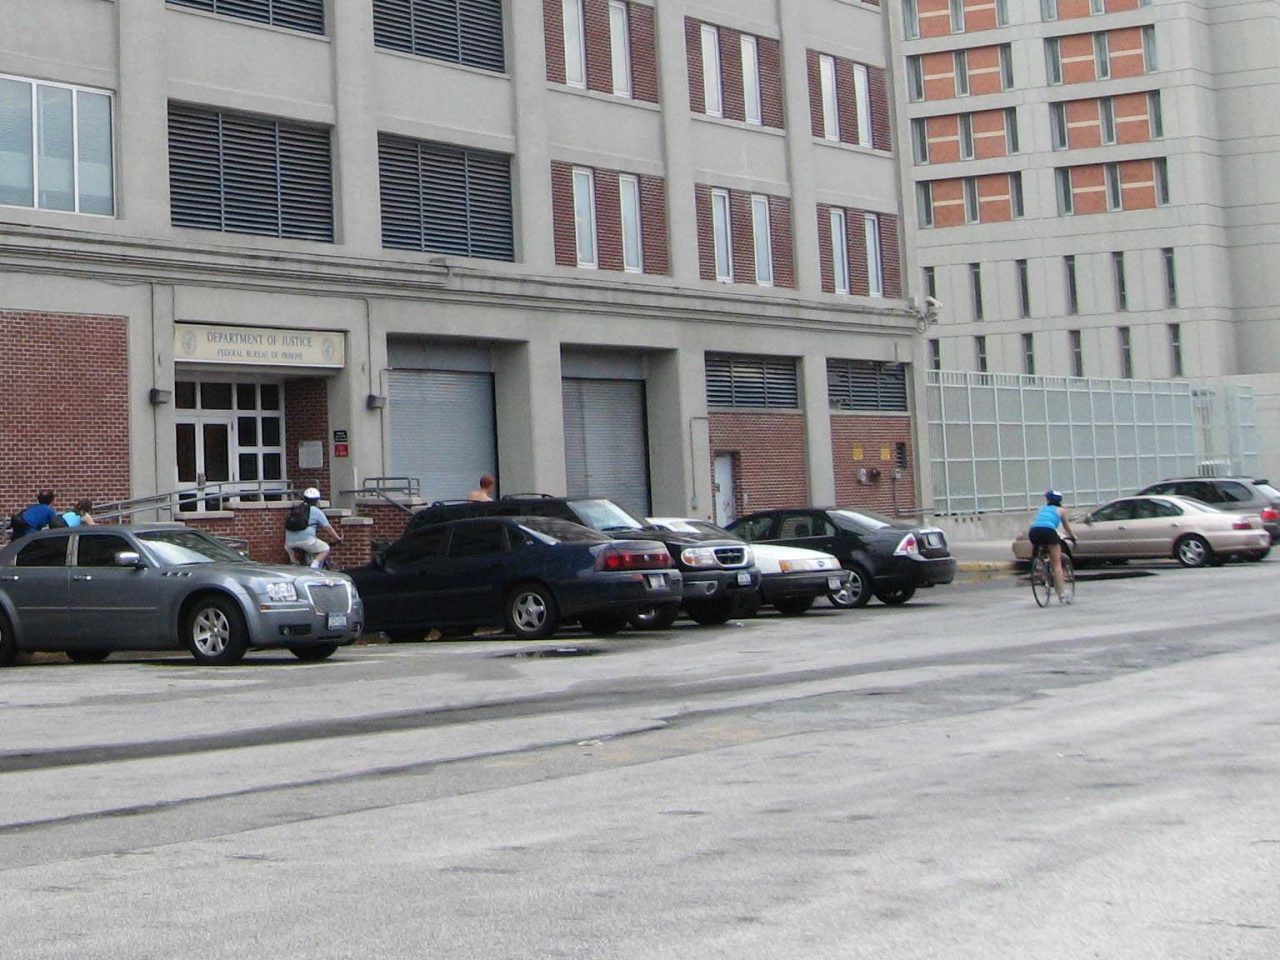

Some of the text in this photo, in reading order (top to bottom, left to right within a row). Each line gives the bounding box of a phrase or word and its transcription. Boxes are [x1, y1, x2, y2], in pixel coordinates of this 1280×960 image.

[207, 331, 312, 348] DEPARTMENT OF JUSTICE
[217, 348, 242, 357] FEDERAL
